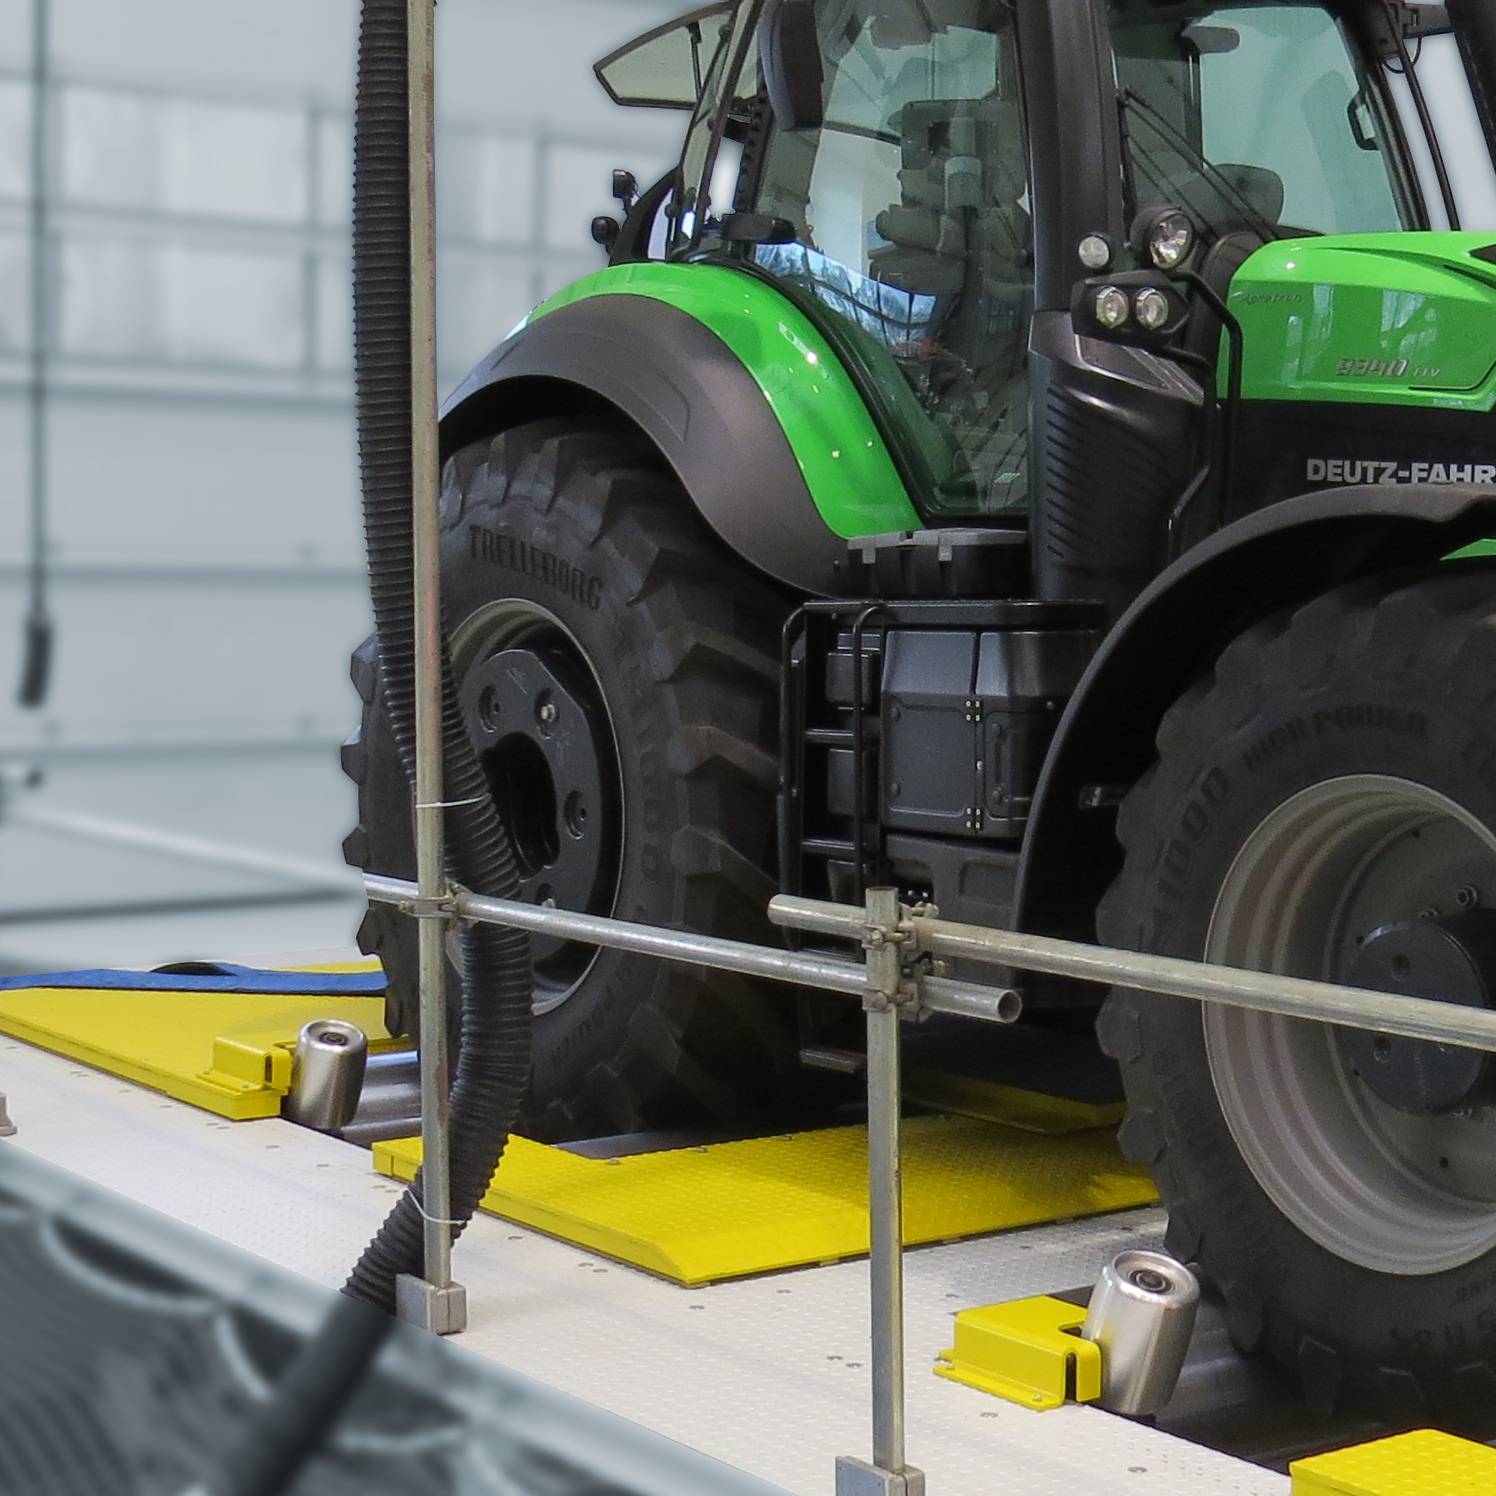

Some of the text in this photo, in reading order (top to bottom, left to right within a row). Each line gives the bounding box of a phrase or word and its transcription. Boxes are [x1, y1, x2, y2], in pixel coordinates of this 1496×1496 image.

[1336, 357, 1409, 377] 9340
[1306, 458, 1496, 484] DEUTZ-FAHR
[469, 524, 602, 611] TRELLEBORG
